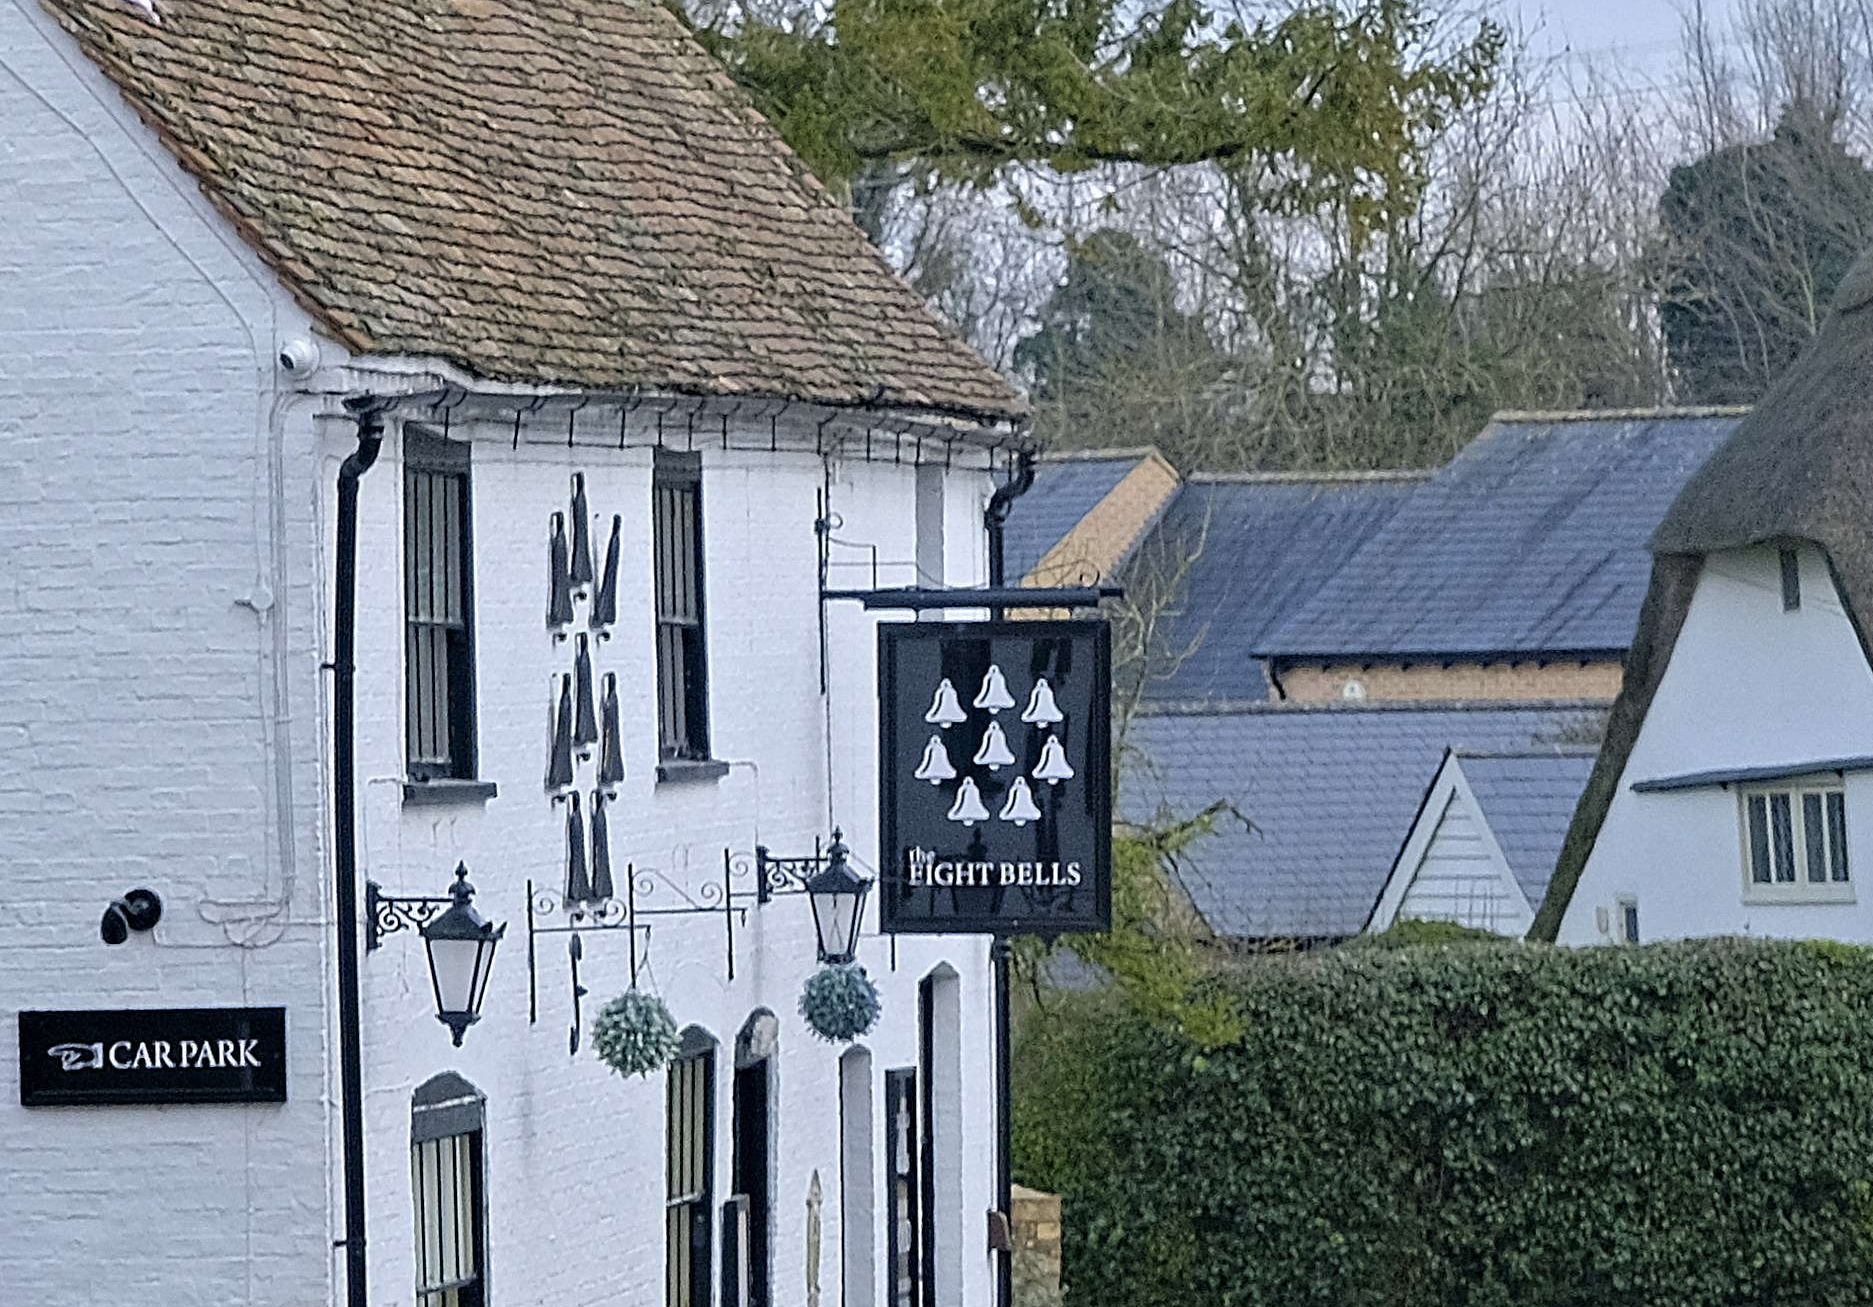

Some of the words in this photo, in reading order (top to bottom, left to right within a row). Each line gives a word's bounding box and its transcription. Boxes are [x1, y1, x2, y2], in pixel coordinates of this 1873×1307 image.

[908, 861, 994, 886] EIGHT
[1000, 861, 1081, 886] BELLS
[109, 1040, 176, 1069] CAR
[179, 1039, 261, 1067] PARK
